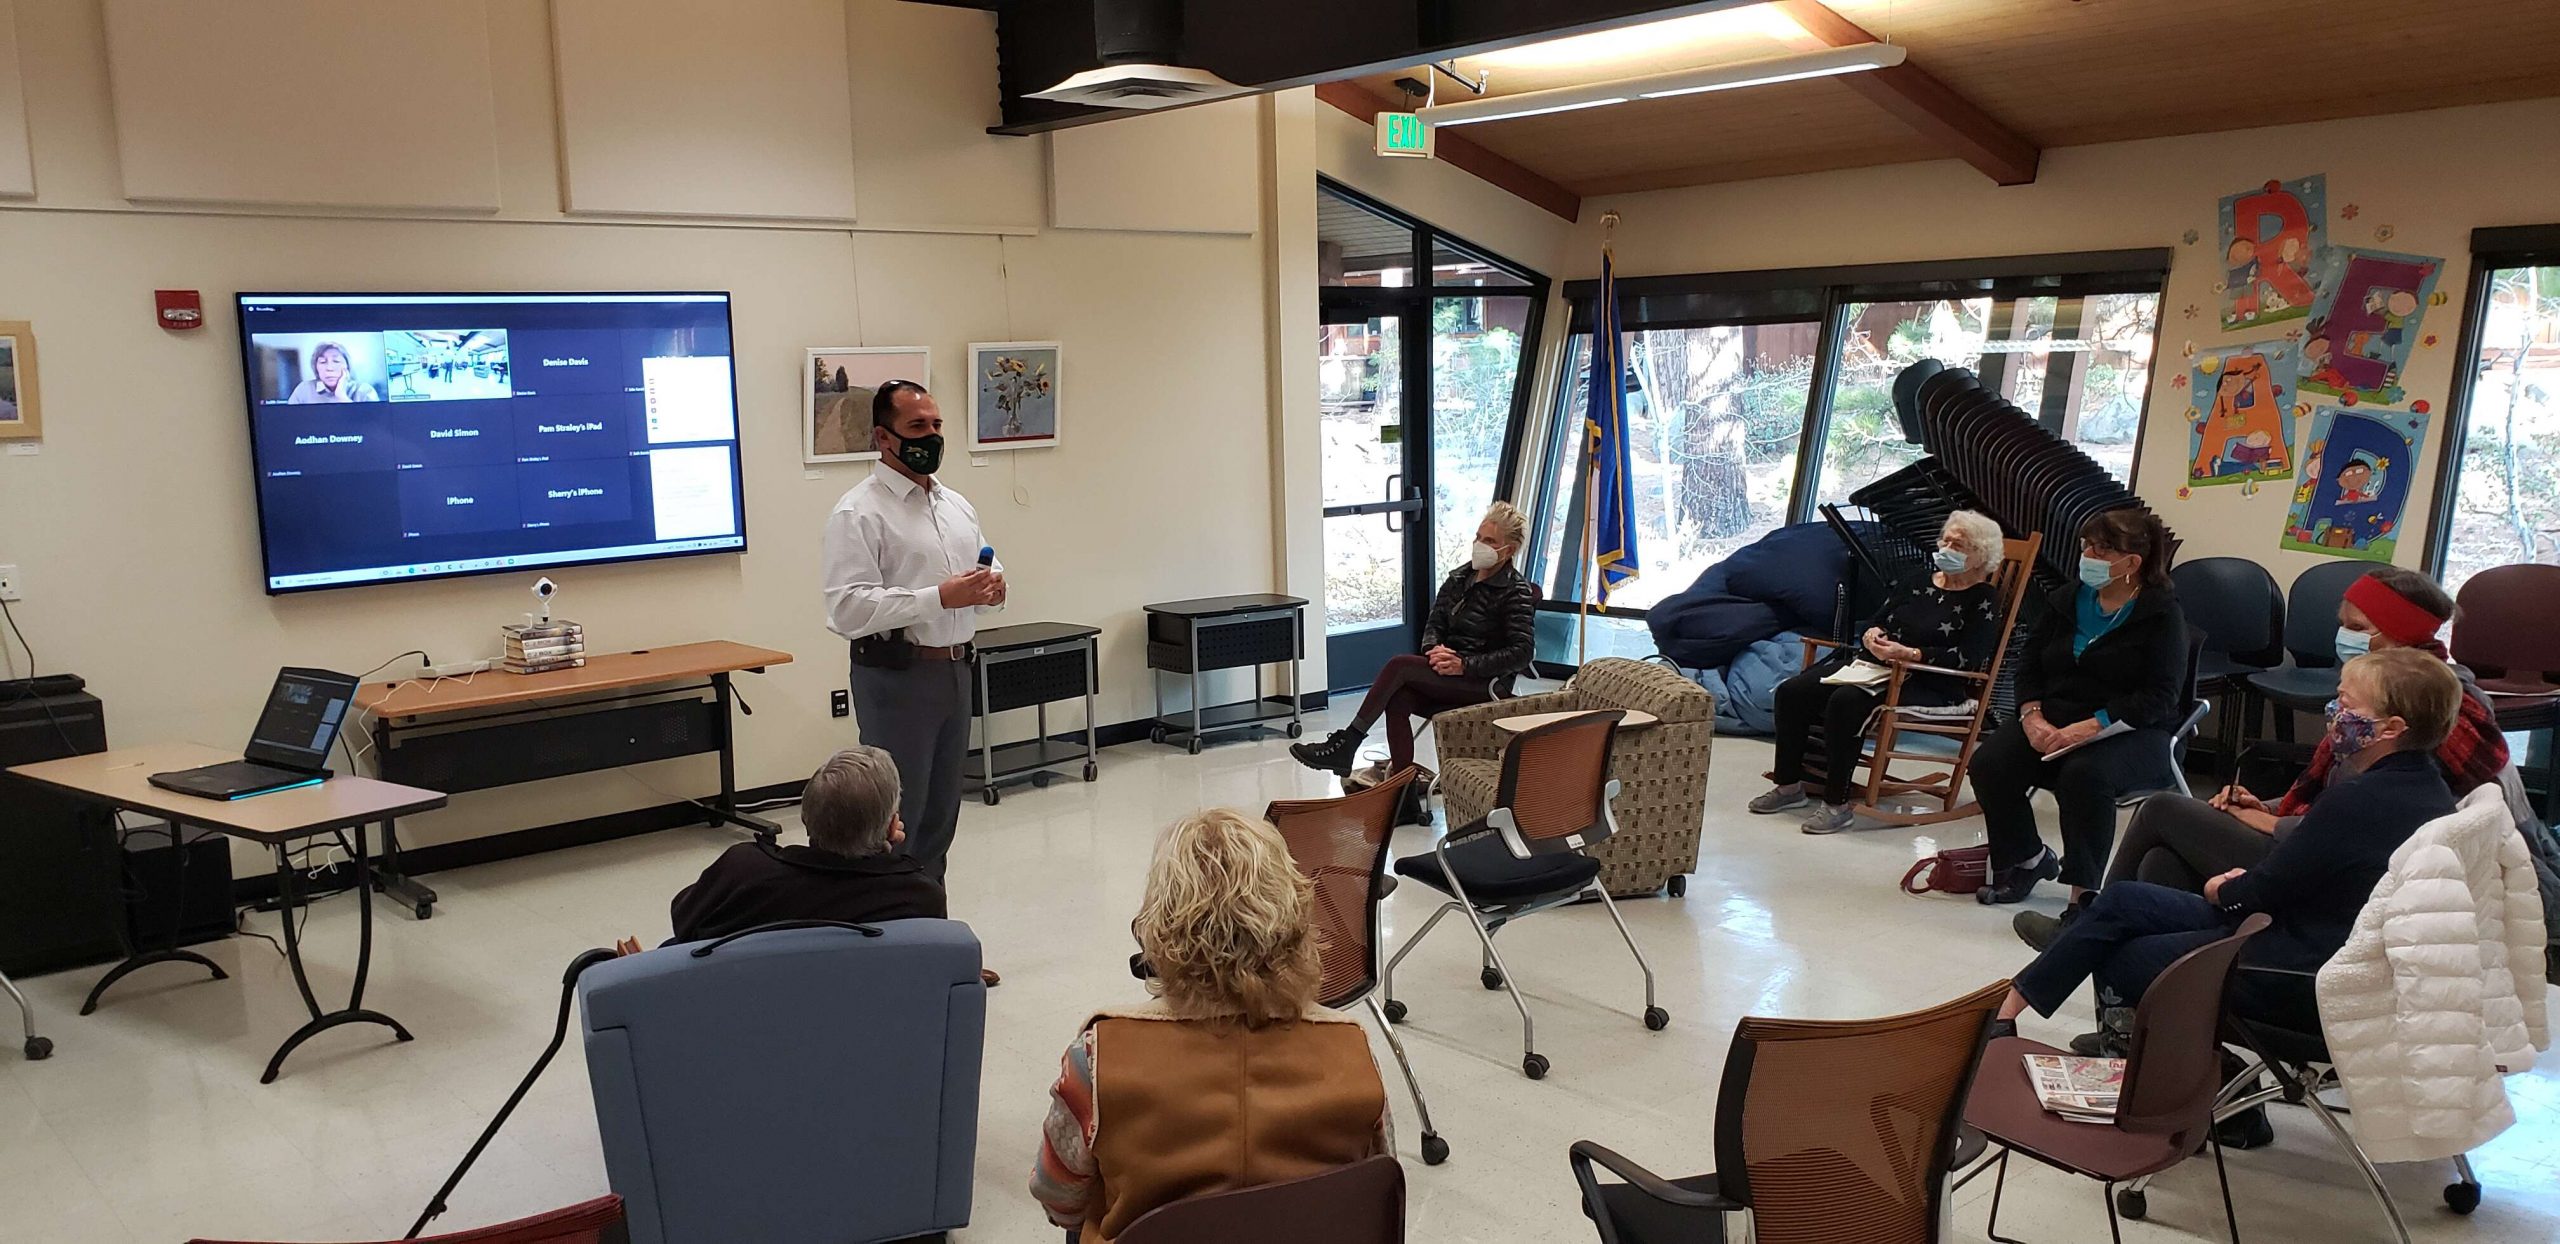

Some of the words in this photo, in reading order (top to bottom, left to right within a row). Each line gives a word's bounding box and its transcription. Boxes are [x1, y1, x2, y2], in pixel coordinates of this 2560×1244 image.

[543, 358, 568, 367] Denise
[568, 358, 588, 366] Davis
[586, 422, 603, 430] iPad
[430, 429, 453, 438] David
[454, 428, 479, 438] Simon
[295, 436, 328, 444] Aodhan
[330, 434, 363, 444] Downey
[548, 490, 577, 498] Sherry's
[578, 488, 603, 496] iPhone
[447, 496, 474, 505] iPhone
